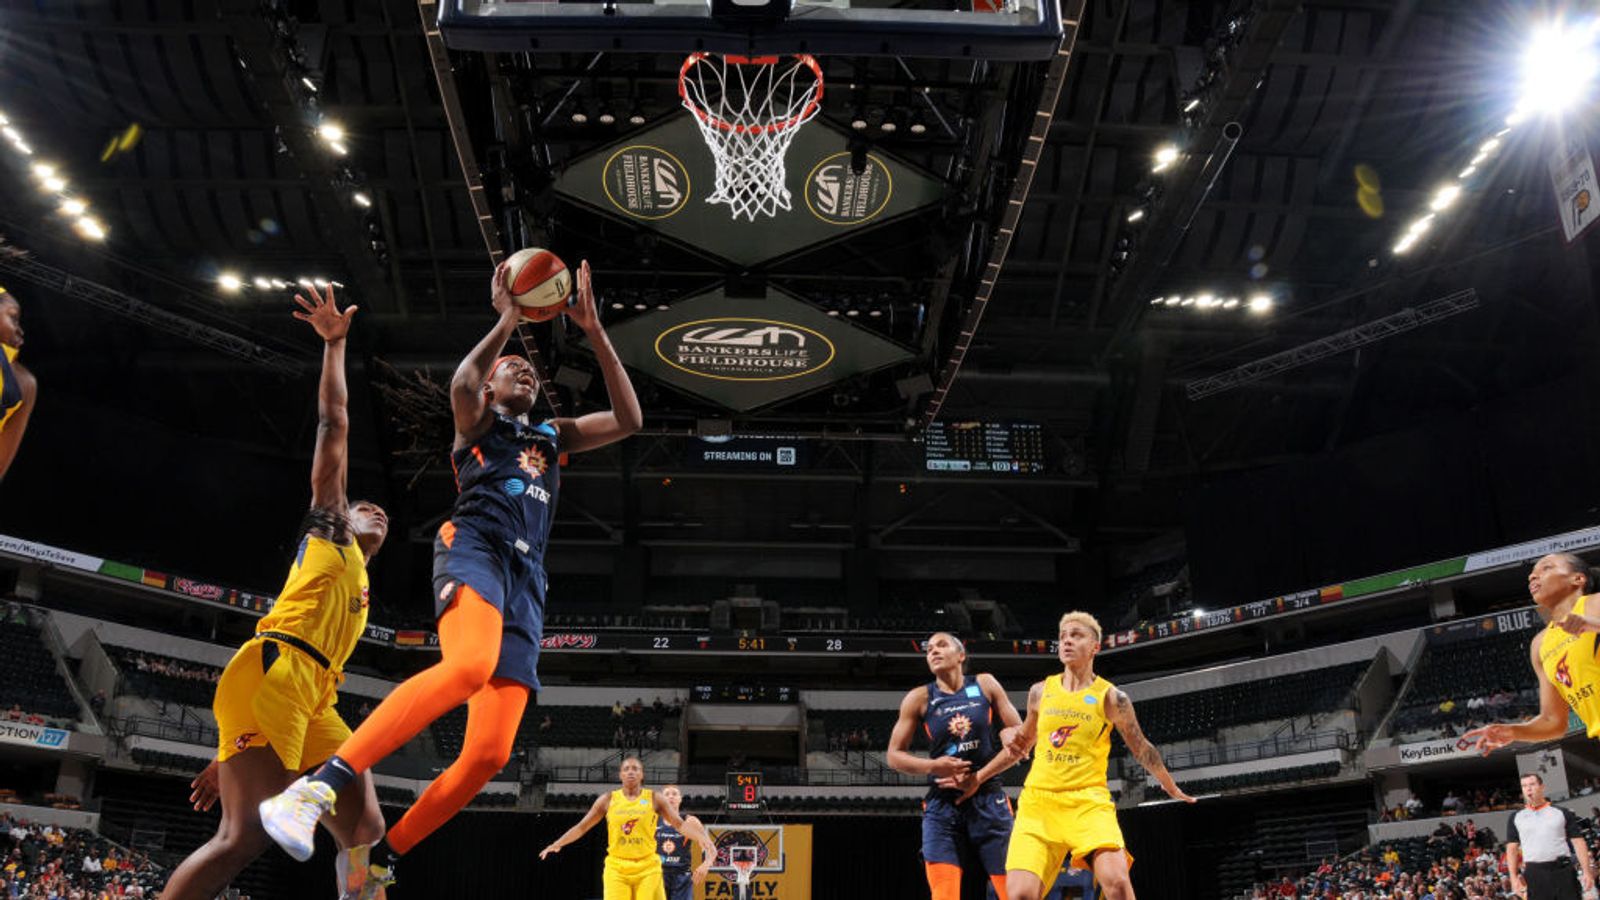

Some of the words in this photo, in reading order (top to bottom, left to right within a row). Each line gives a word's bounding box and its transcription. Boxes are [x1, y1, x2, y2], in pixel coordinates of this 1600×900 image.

[678, 344, 772, 357] BANKERS
[774, 349, 808, 358] LIFE
[678, 355, 808, 368] FIELDHOUSE
[703, 451, 758, 461] STREAMING
[759, 451, 772, 461] ON
[525, 484, 551, 504] AT&T
[1498, 611, 1532, 633] BLUE
[653, 637, 670, 649] 22
[738, 638, 765, 650] 5:41
[826, 639, 842, 650] 28
[958, 741, 980, 752] AT&T
[1401, 744, 1455, 761] KeyBank
[745, 785, 755, 801] 8
[705, 881, 778, 896] FAILY
